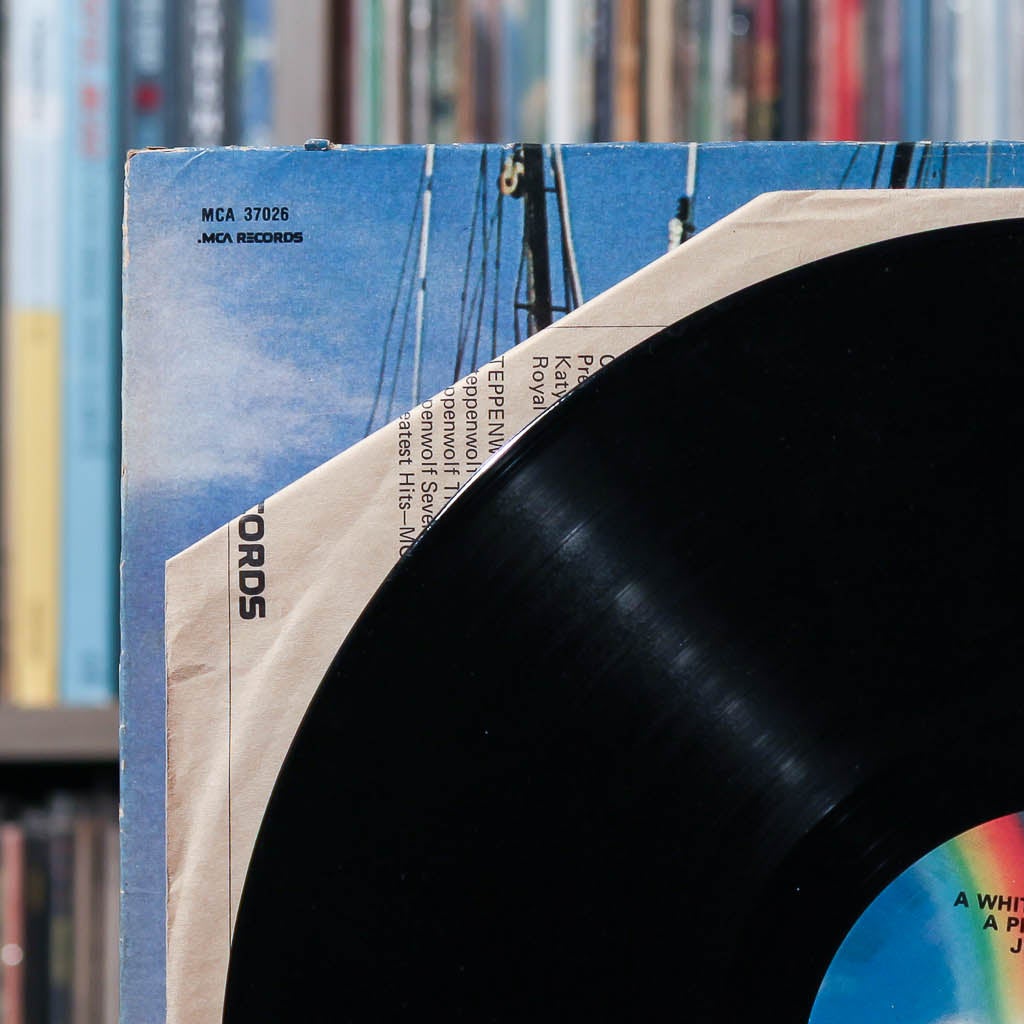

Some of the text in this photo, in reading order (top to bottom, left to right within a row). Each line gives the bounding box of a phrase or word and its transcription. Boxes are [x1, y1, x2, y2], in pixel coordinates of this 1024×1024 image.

[201, 206, 289, 222] MCA 37026
[236, 231, 304, 244] RECORDS
[529, 356, 549, 410] Royal
[551, 356, 571, 398] Katy
[238, 502, 266, 620] ORDS
[953, 892, 969, 907] A
[983, 915, 998, 931] A
